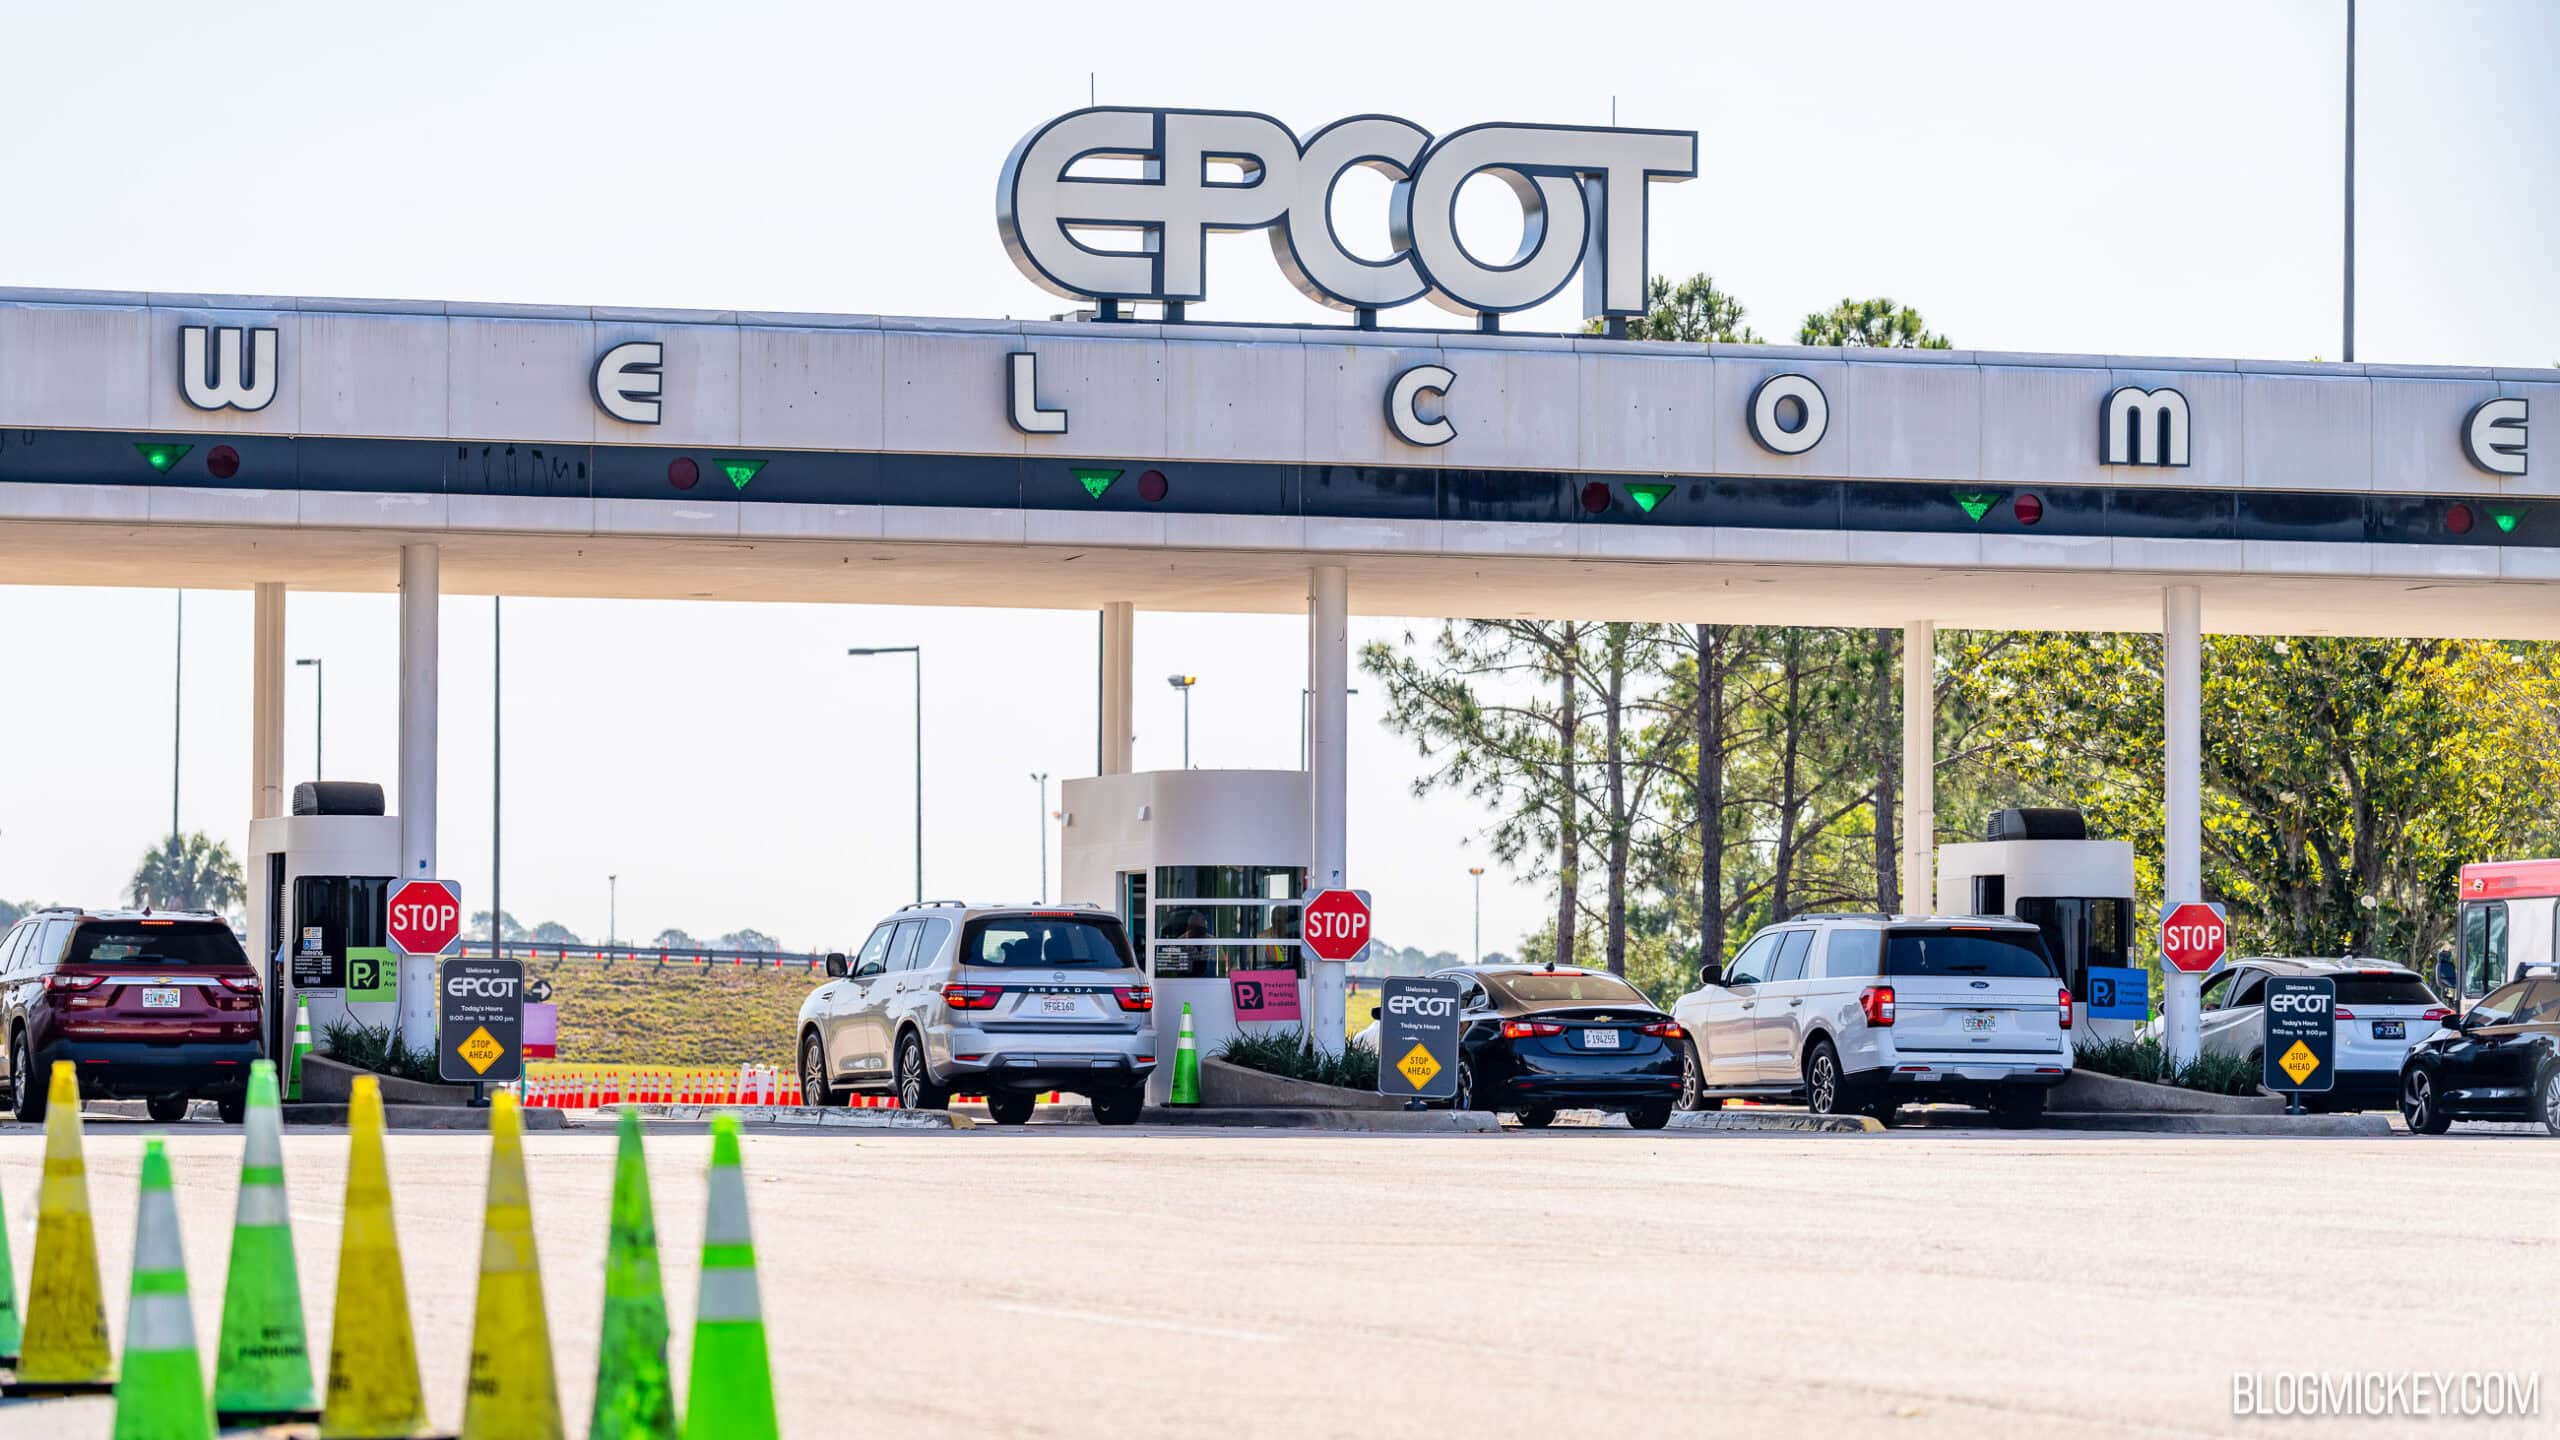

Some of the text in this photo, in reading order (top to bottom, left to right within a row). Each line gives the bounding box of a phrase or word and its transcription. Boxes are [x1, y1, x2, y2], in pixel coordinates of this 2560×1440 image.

[997, 106, 1699, 317] EPCOT
[393, 904, 455, 931] STOP
[1308, 911, 1367, 939] STOP
[2167, 925, 2222, 951] STOP
[447, 977, 519, 997] EPCOT
[1405, 985, 1430, 993] Welcome
[1388, 995, 1456, 1016] EPCOT
[2270, 994, 2331, 1013] EPCOT
[1400, 1022, 1423, 1030] Today's
[471, 1040, 491, 1048] STOP
[468, 1051, 493, 1059] AHEAD
[2290, 1052, 2308, 1060] STOP
[1410, 1056, 1429, 1065] STOP
[1407, 1067, 1432, 1076] AHEAD
[2288, 1063, 2310, 1071] AHEAD
